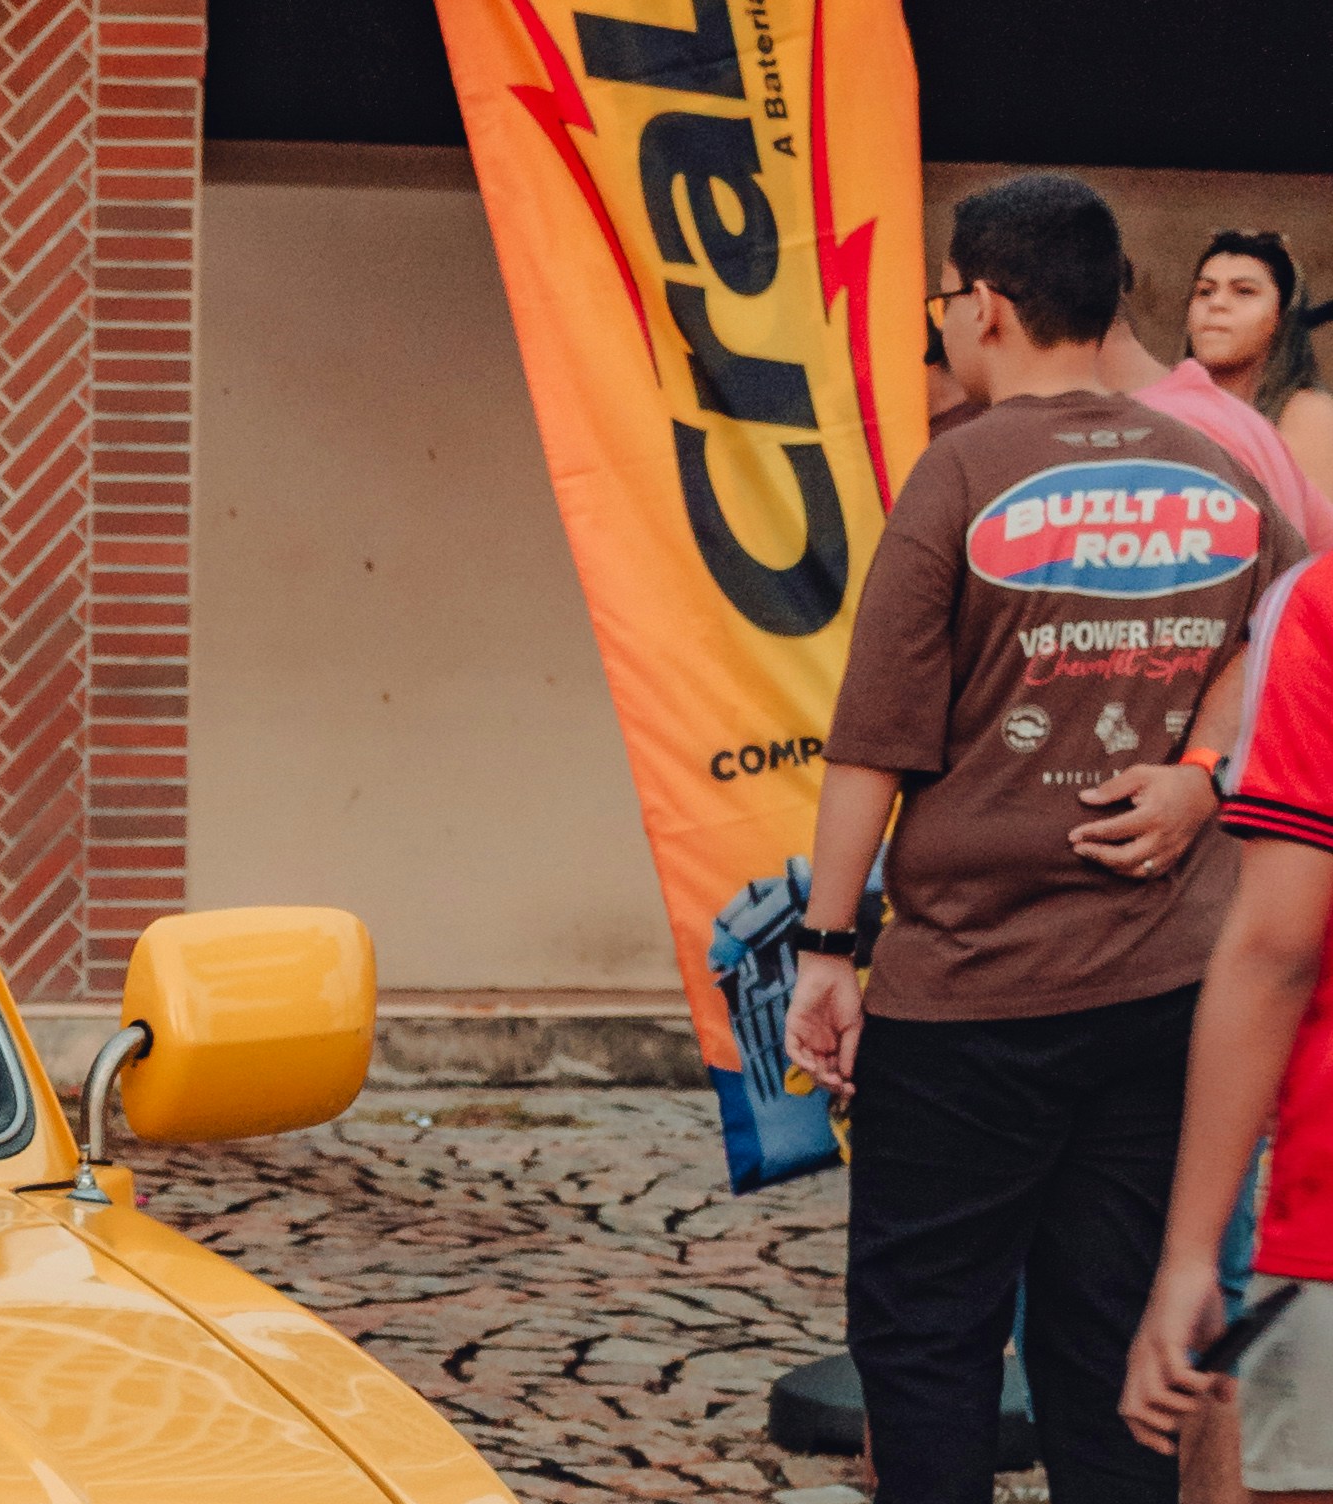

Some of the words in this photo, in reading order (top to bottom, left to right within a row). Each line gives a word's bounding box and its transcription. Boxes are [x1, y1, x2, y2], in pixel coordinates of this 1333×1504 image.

[772, 134, 798, 159] A
[1004, 487, 1165, 541] BUILT
[1179, 487, 1237, 522] TO
[1072, 528, 1213, 569] ROAR
[1017, 622, 1057, 658] V8
[1059, 619, 1150, 652] POWER
